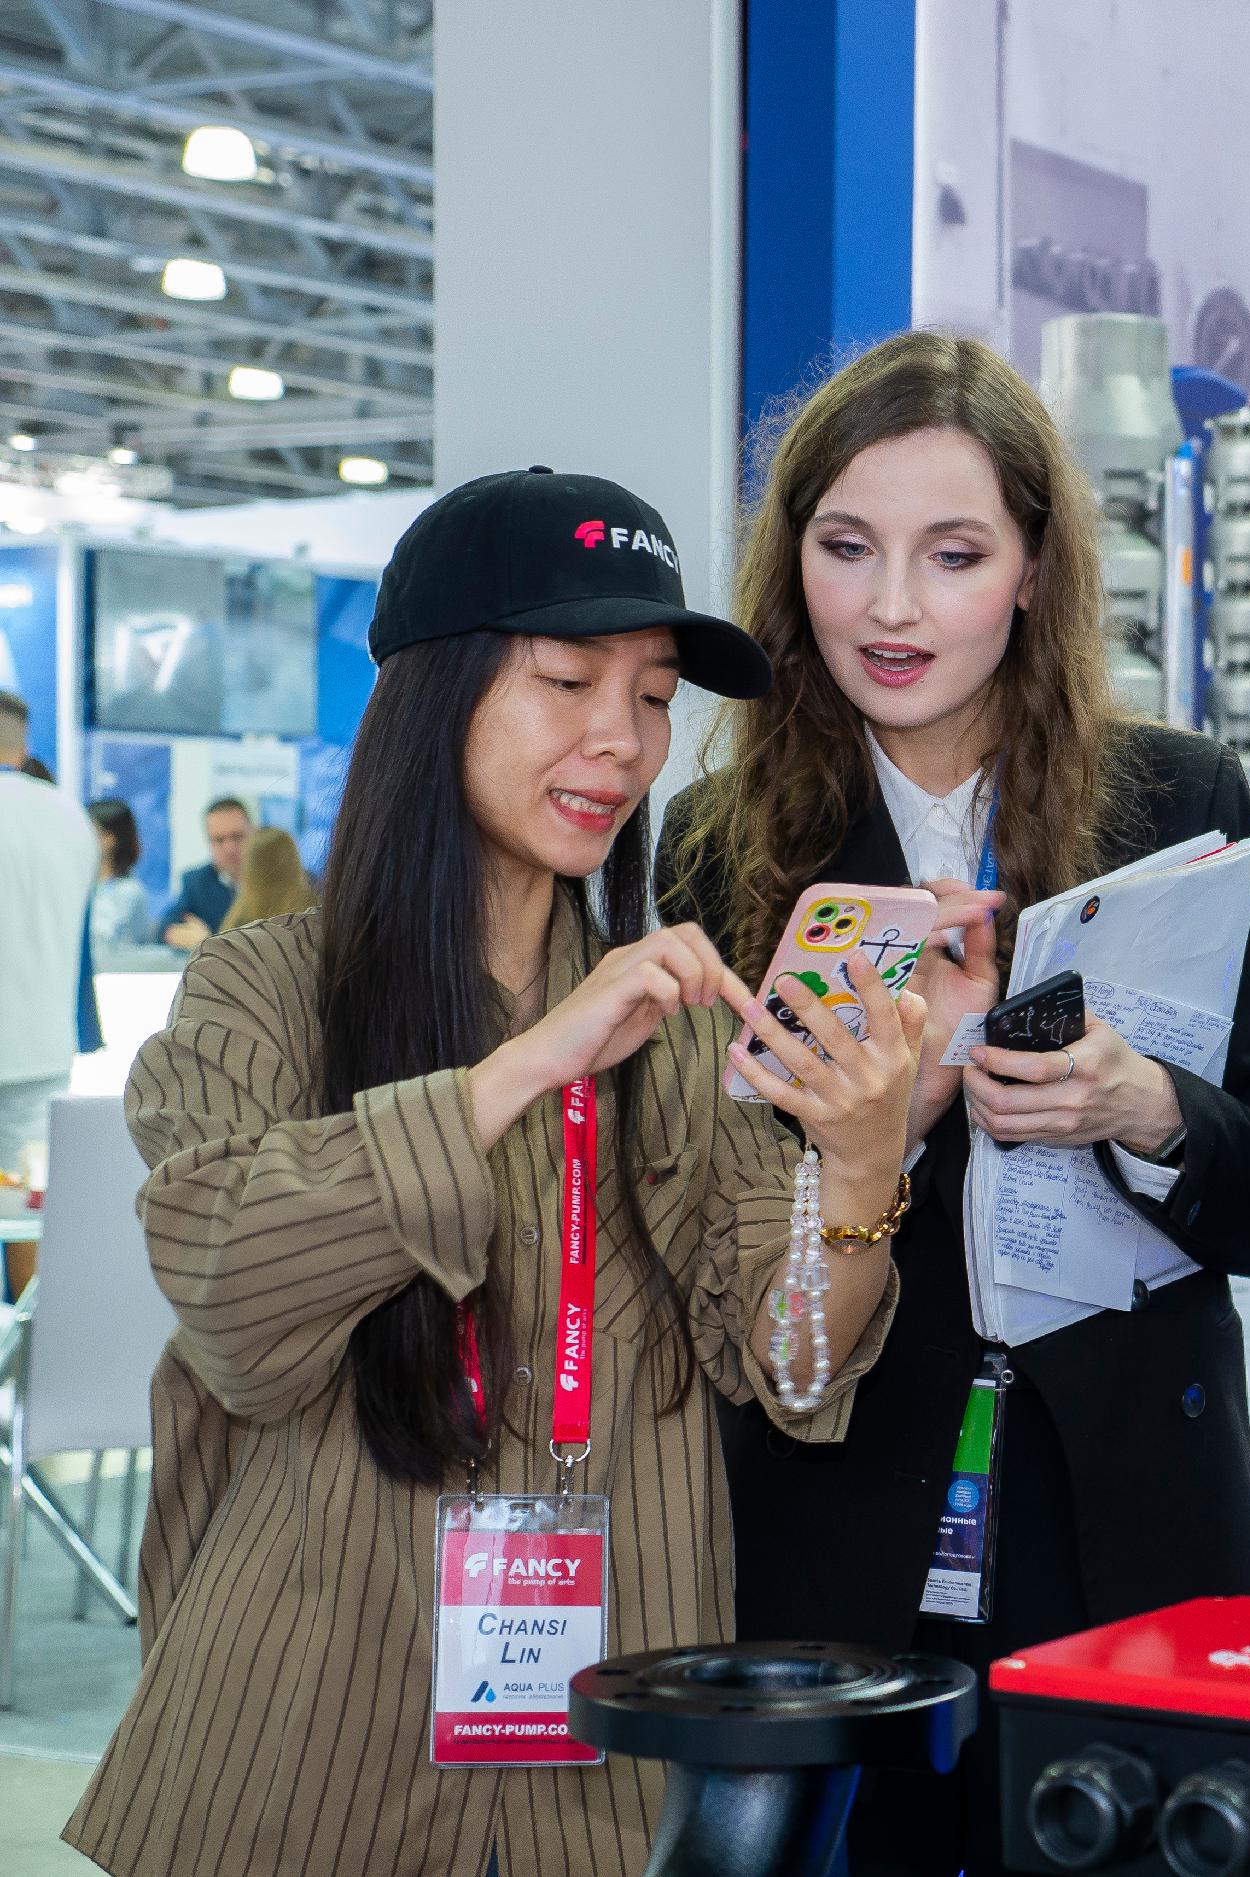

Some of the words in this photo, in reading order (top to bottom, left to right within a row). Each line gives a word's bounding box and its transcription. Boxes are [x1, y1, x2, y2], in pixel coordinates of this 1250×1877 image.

[564, 1302, 581, 1371] FANCY
[493, 1557, 581, 1578] FANCY
[503, 1682, 534, 1692] AQUA
[538, 1682, 565, 1692] PLUS
[453, 1724, 569, 1736] FANCY-PUMP.CO
